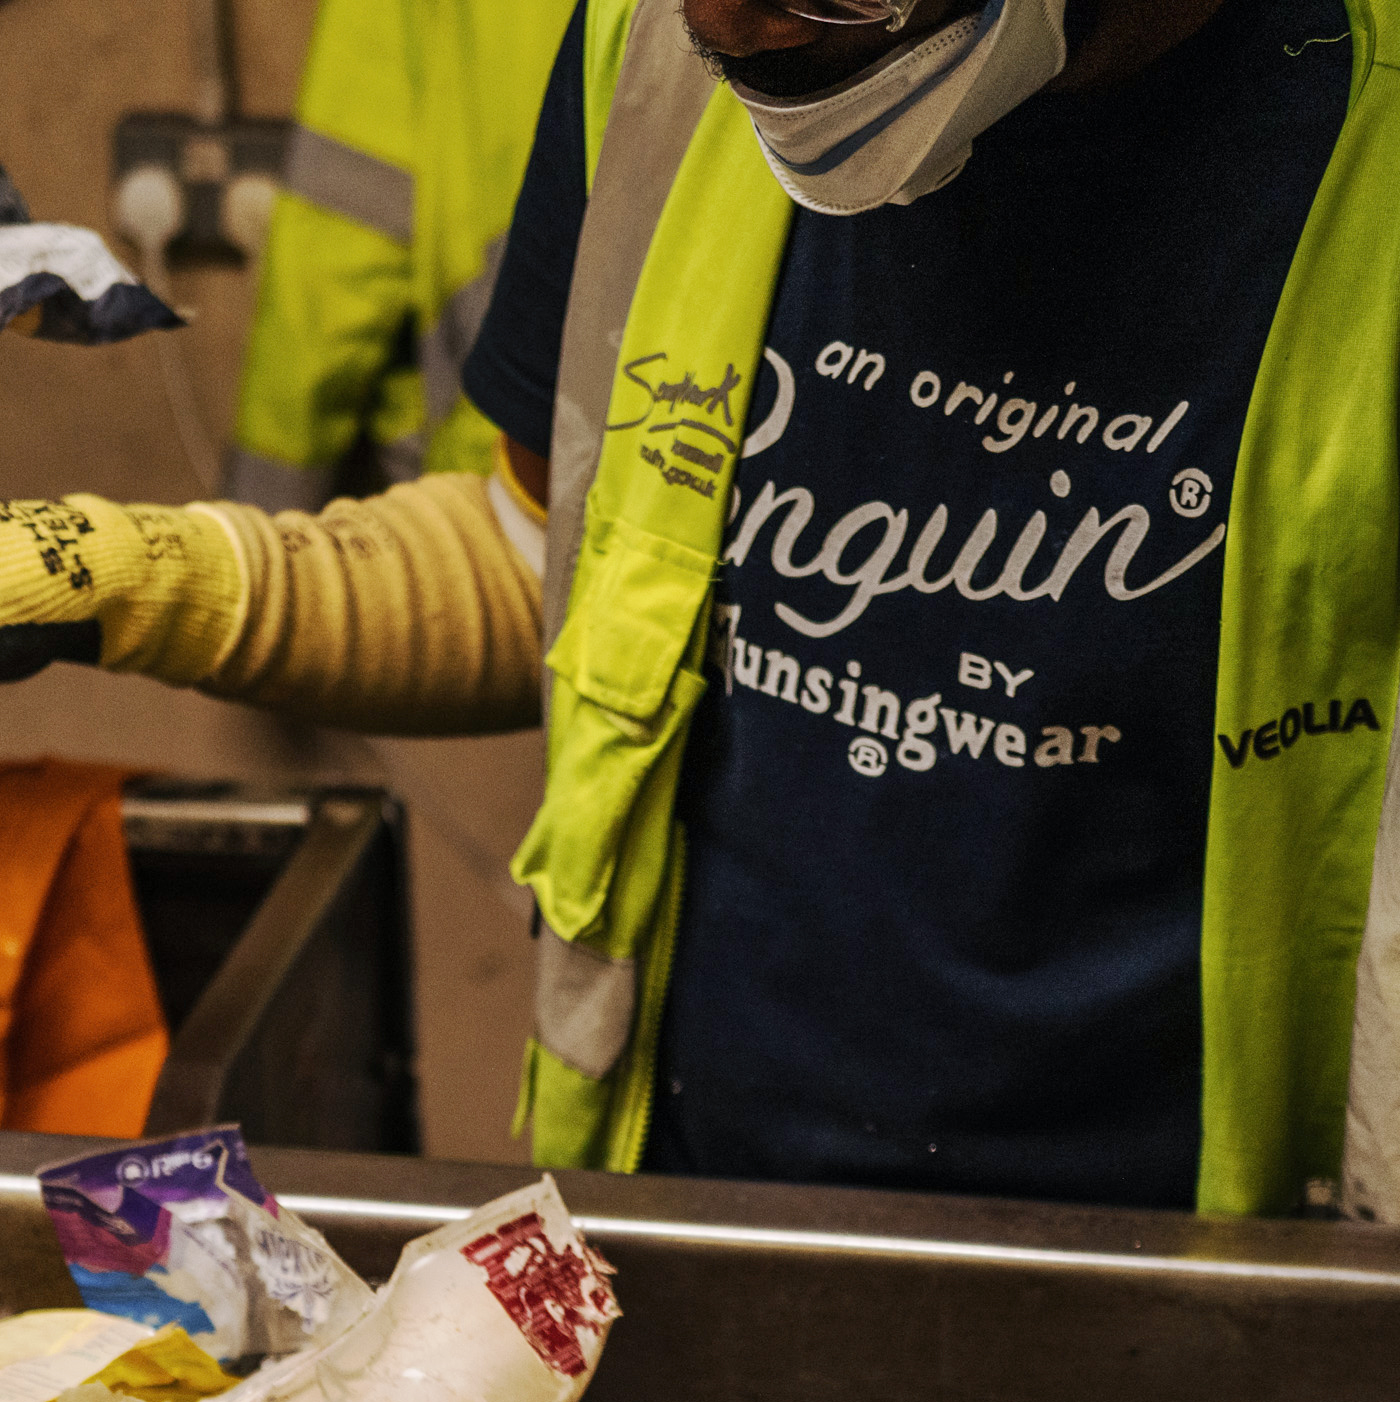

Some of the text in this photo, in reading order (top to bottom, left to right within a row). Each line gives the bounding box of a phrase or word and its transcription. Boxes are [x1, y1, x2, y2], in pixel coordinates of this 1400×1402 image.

[815, 339, 1190, 455] an original
[958, 652, 1034, 698] BY
[1218, 696, 1381, 769] VEOLIA
